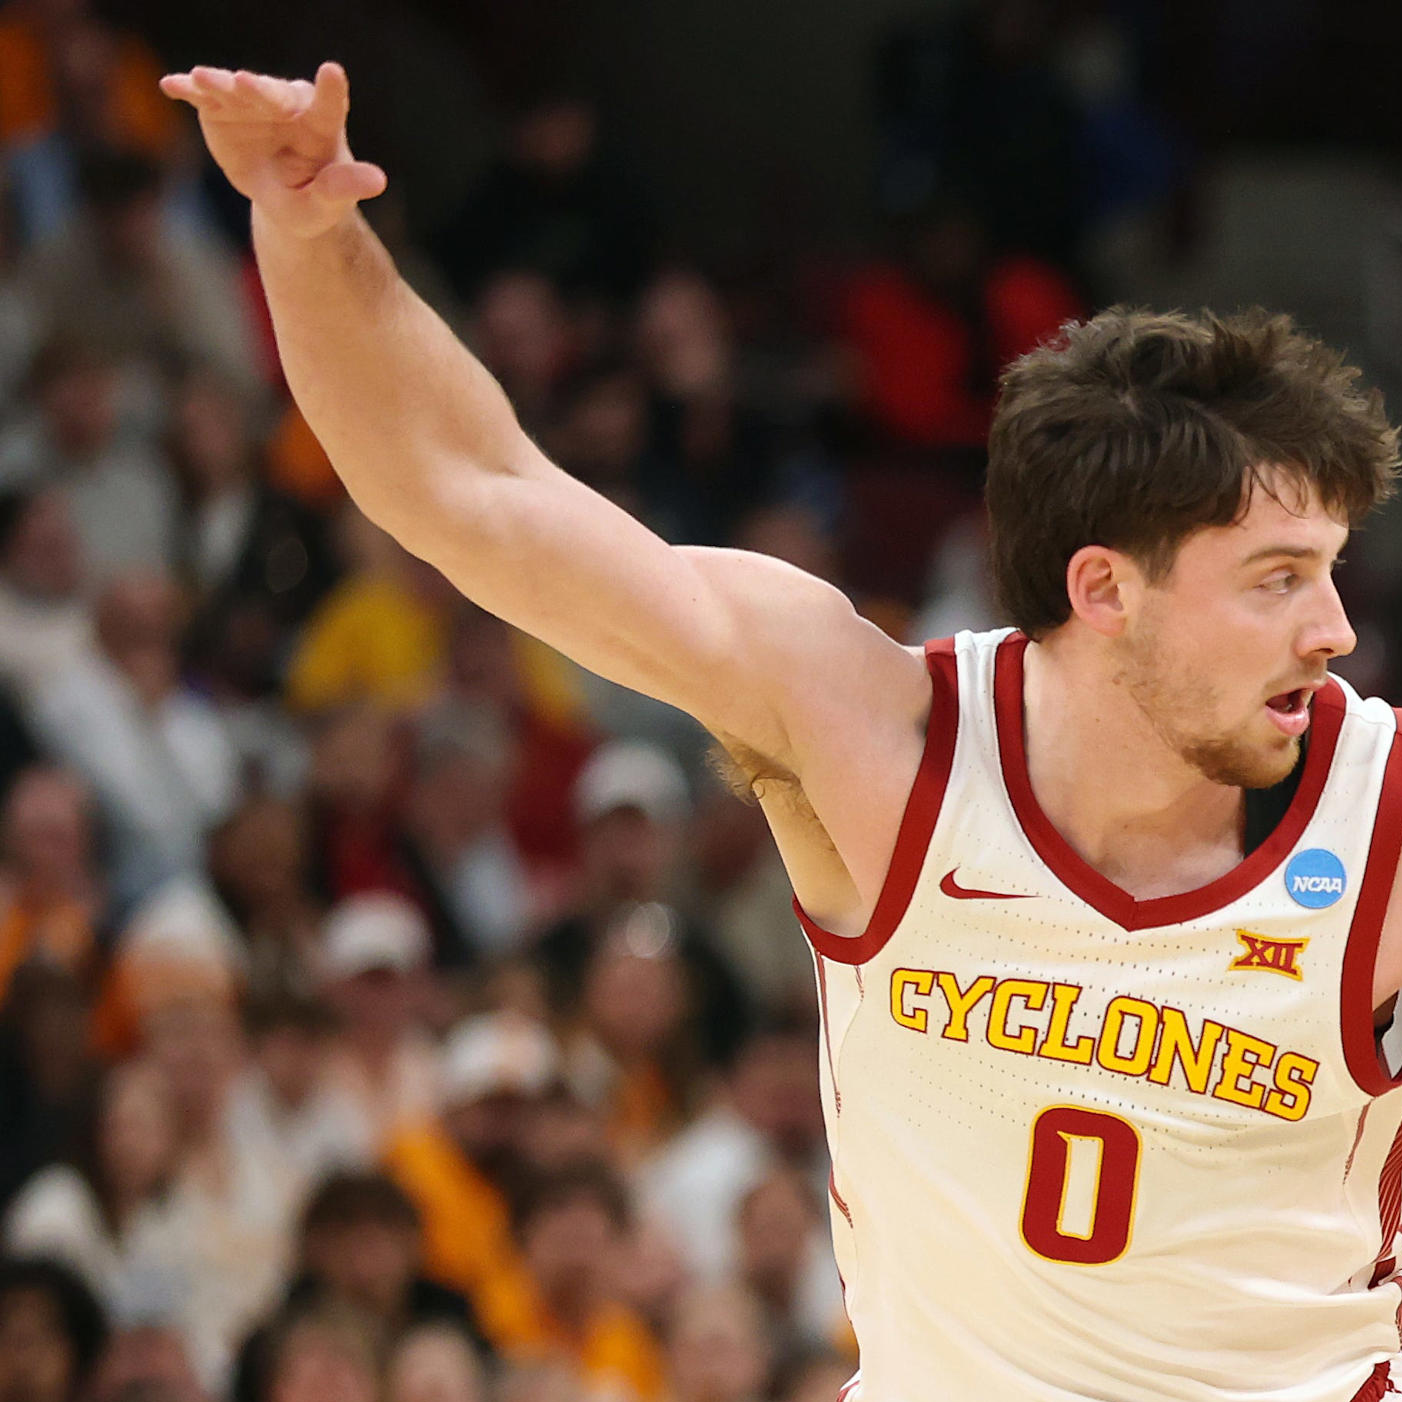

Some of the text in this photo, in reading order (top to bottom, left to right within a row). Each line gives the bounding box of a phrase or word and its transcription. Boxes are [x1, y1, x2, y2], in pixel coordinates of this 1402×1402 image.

[1293, 876, 1343, 894] NCAA
[1233, 932, 1305, 978] XII
[890, 967, 1319, 1122] CYCLONES
[1019, 1104, 1143, 1267] 0
